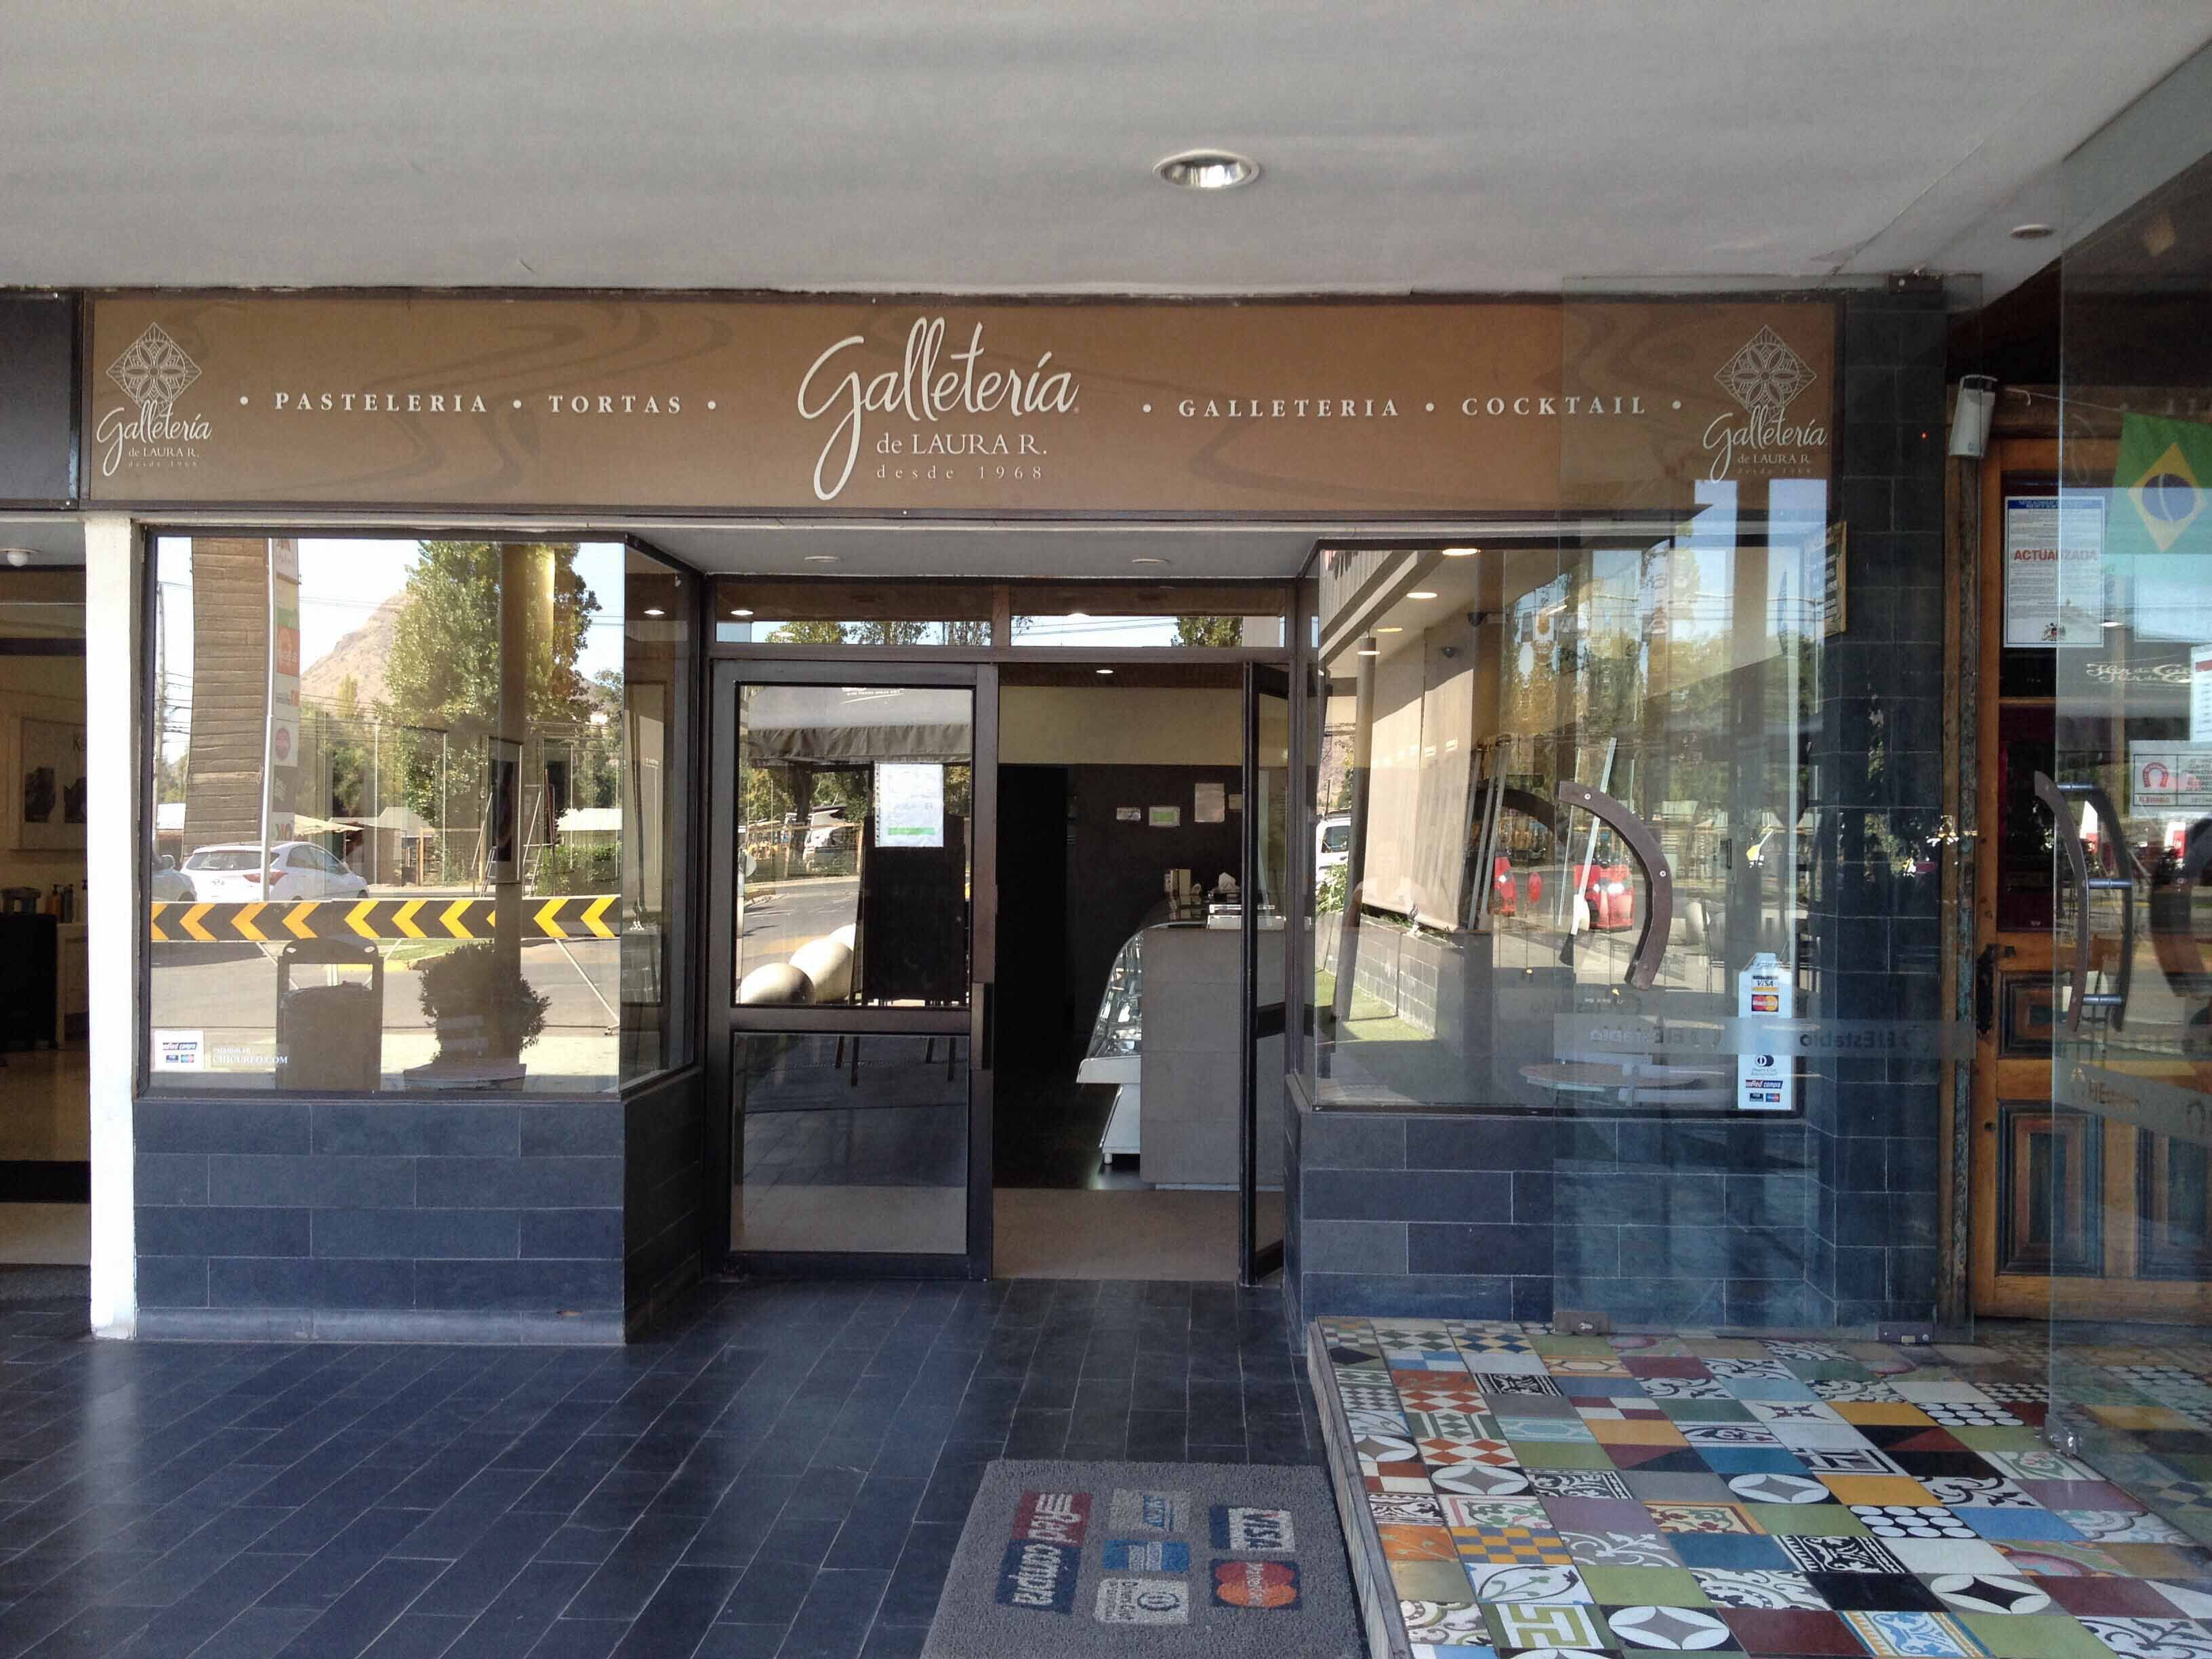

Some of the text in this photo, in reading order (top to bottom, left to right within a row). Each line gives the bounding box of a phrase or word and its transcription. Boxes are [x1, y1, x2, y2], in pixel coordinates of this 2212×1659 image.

[275, 392, 682, 414] PASTELERIA TORTAS
[798, 316, 1079, 501] Galletería
[1178, 395, 1647, 417] GALLETERIA COCKTAIL
[96, 399, 211, 477] Galletería
[876, 432, 1048, 455] de LAURA R.
[1703, 405, 1828, 483] Galletería
[128, 447, 200, 458] de LAURA R.
[1738, 454, 1748, 464] de
[1753, 455, 1796, 464] LAURA
[876, 466, 1042, 479] desde 1968
[1244, 1513, 1282, 1549] VISA
[1008, 1544, 1063, 1605] compra
